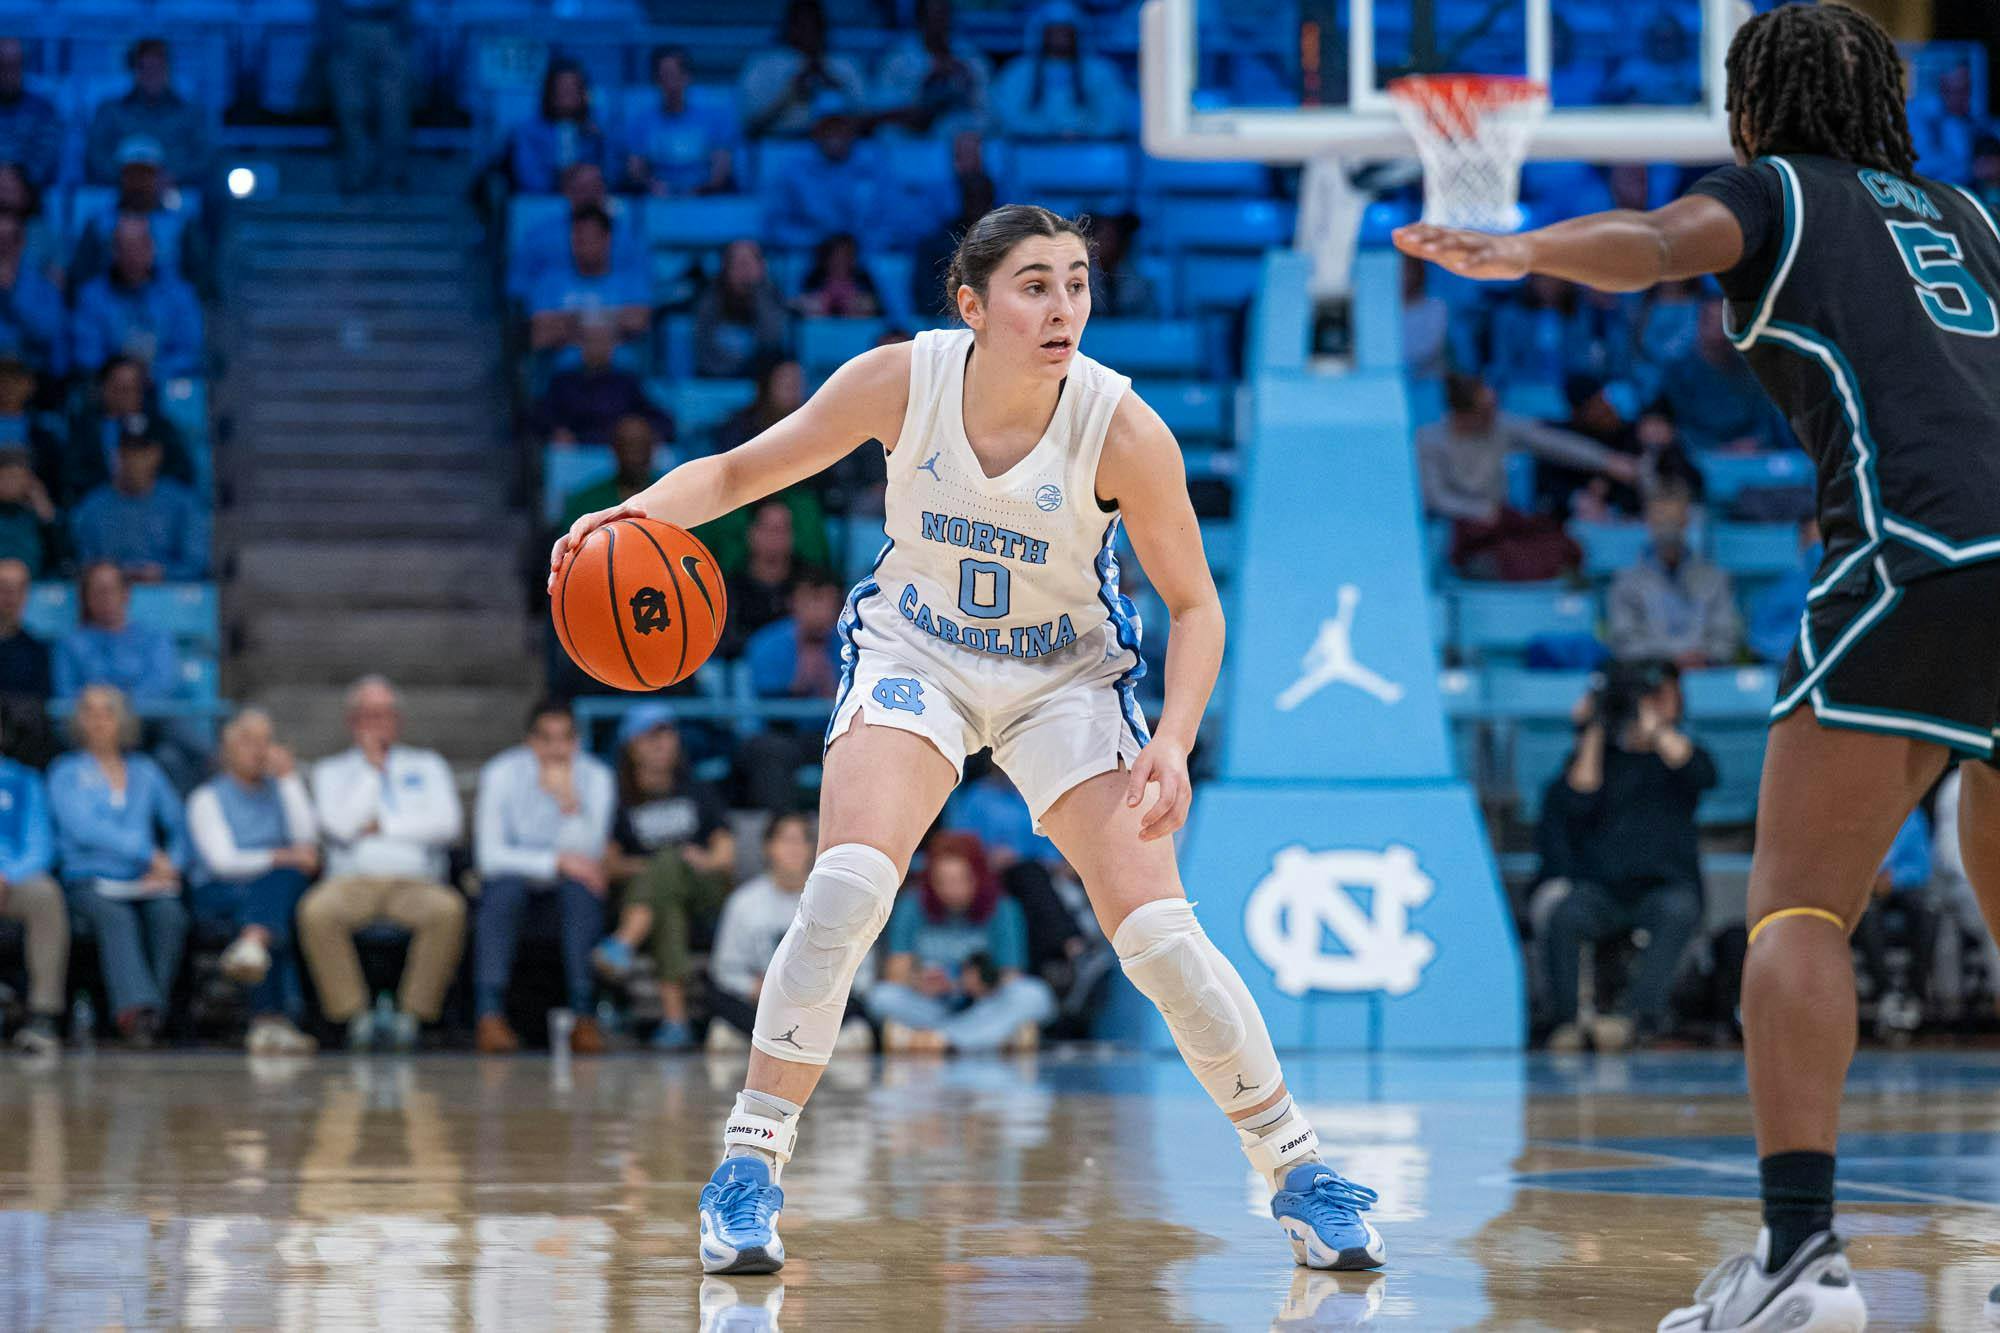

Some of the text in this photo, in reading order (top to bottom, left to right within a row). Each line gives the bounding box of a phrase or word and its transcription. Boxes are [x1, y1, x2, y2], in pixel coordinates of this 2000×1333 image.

[1885, 219, 1999, 337] 5
[922, 511, 1049, 564] NORTH
[899, 583, 1077, 658] CAROLINA
[958, 557, 1010, 619] 0
